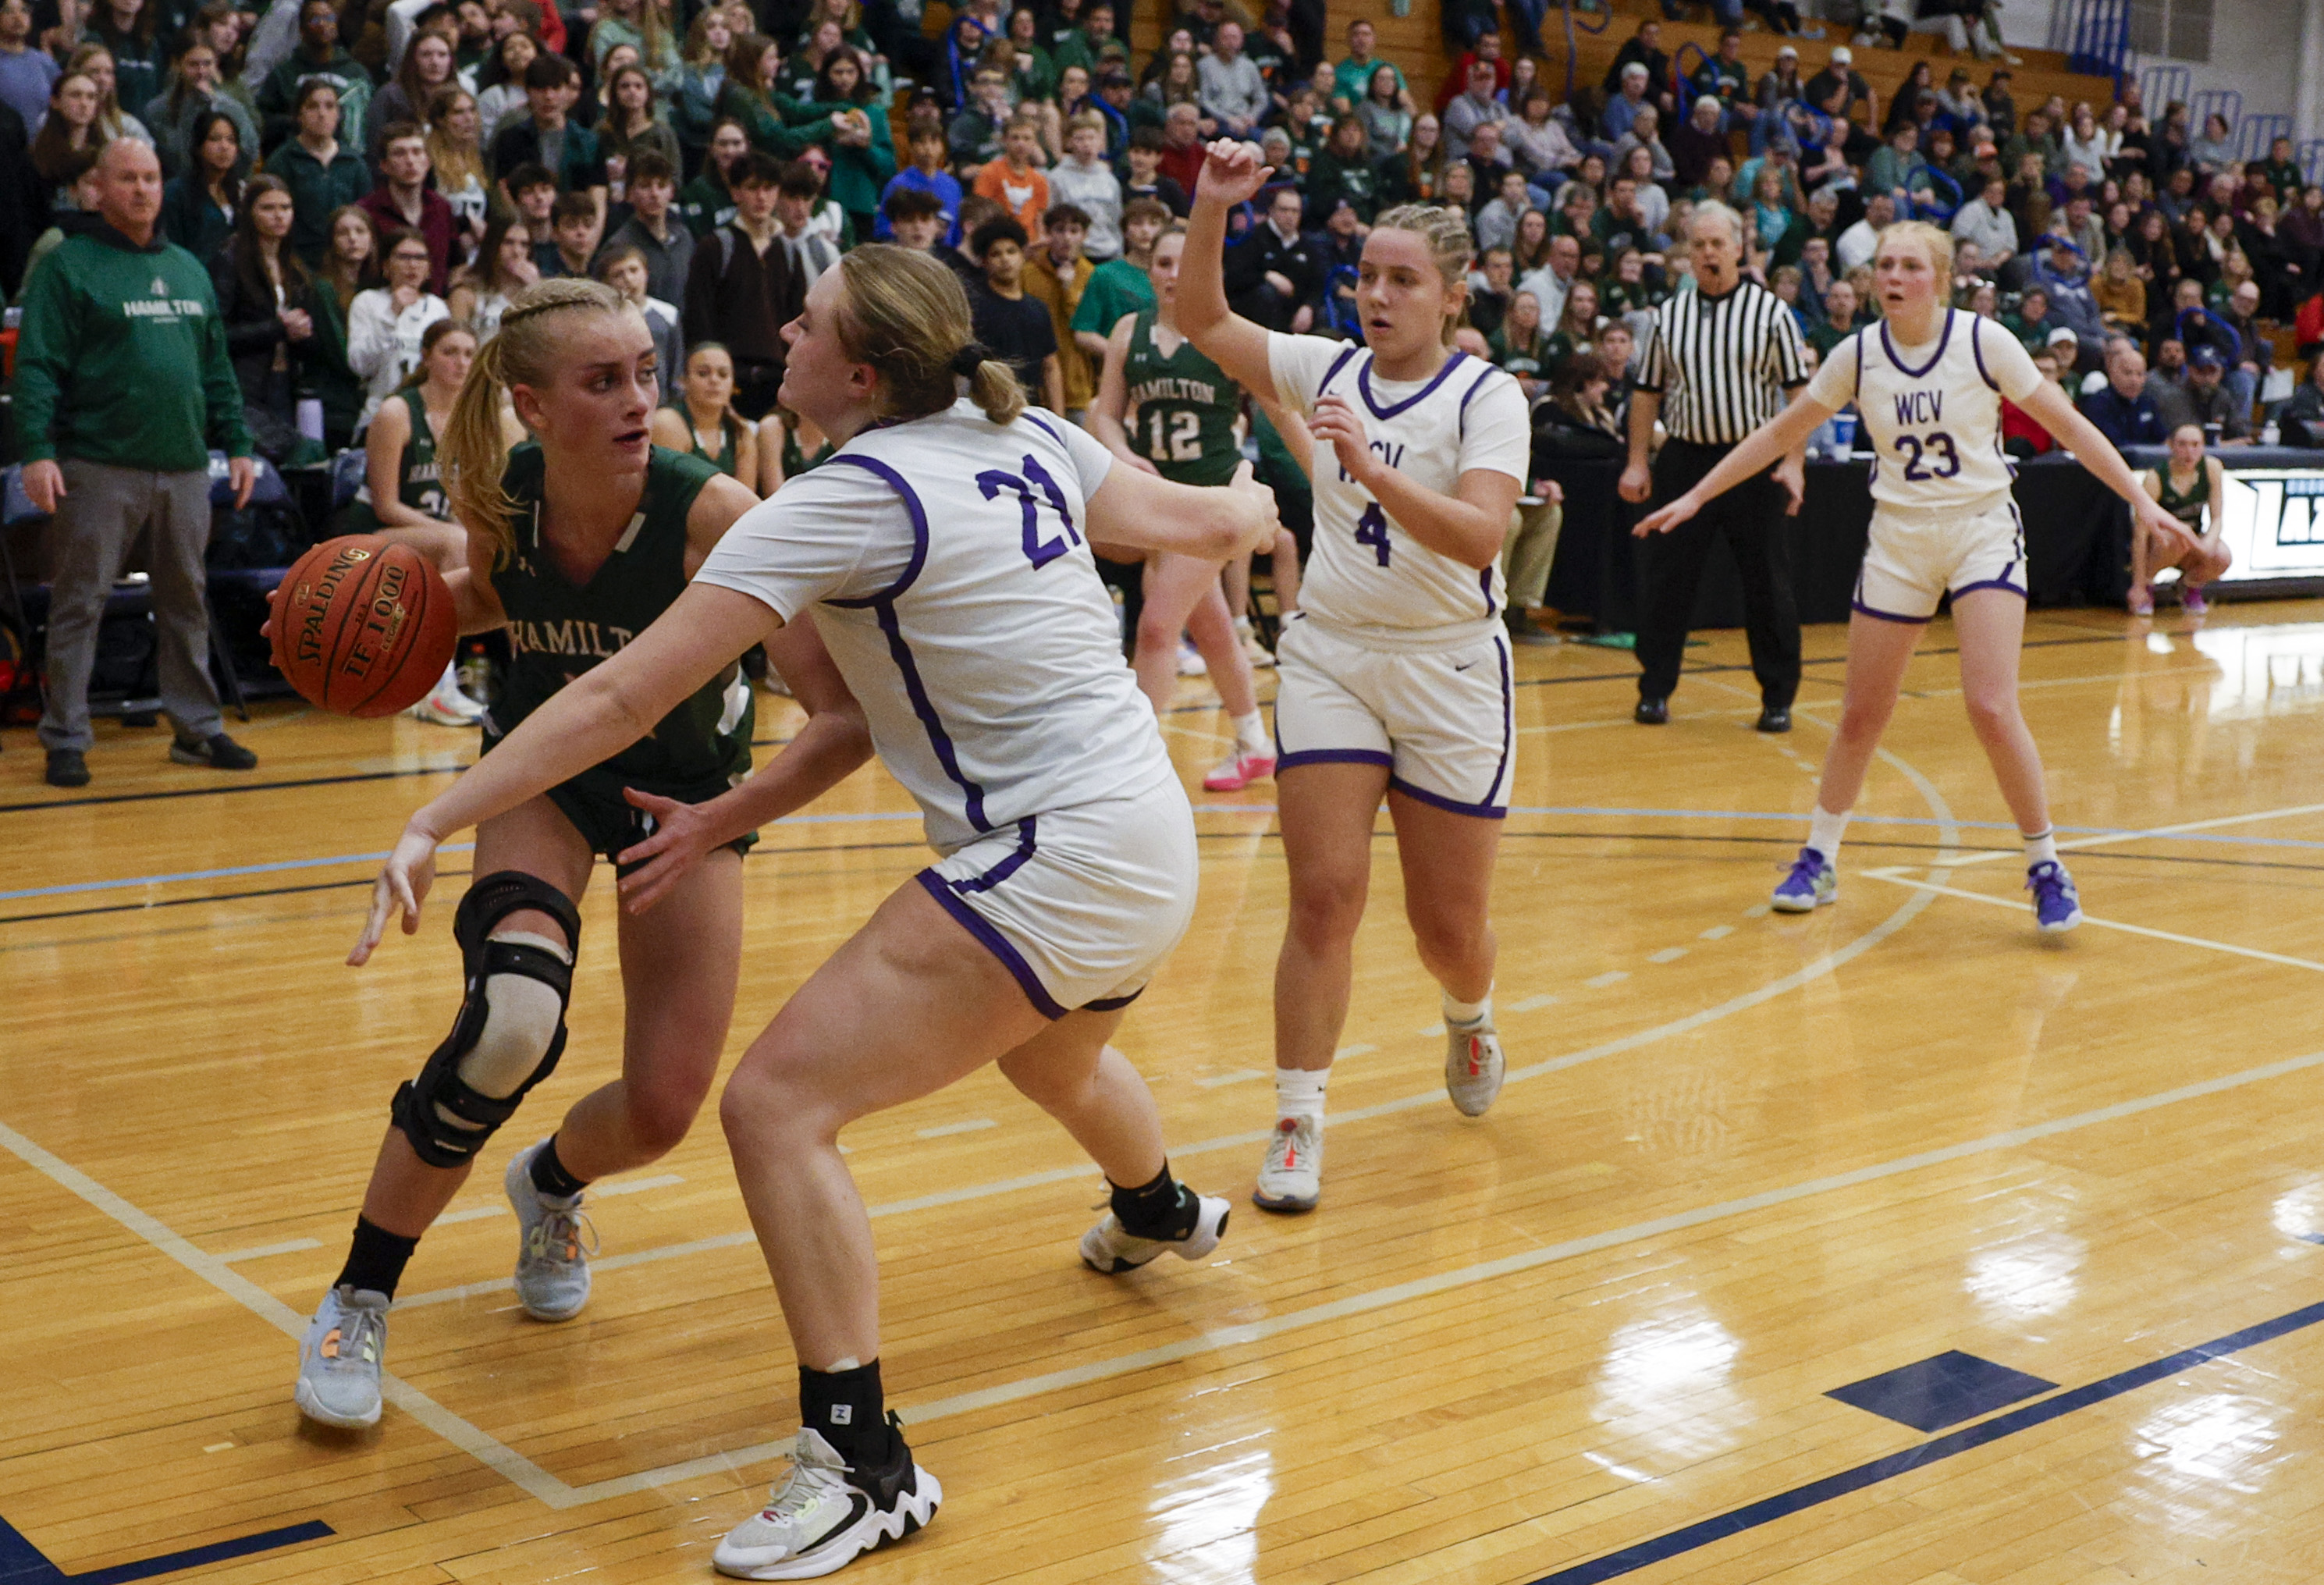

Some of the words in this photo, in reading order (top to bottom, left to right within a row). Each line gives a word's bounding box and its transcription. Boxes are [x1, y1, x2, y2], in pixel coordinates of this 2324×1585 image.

[1130, 378, 1215, 405] HAMILTON
[1894, 389, 1942, 425] WCV
[1149, 409, 1203, 461] 12
[1895, 432, 1960, 481] 23
[975, 453, 1081, 571] 21
[1355, 501, 1392, 567] 4
[297, 547, 359, 666] SPALDING
[367, 565, 406, 635] 1000
[510, 619, 633, 663] HAMILT
